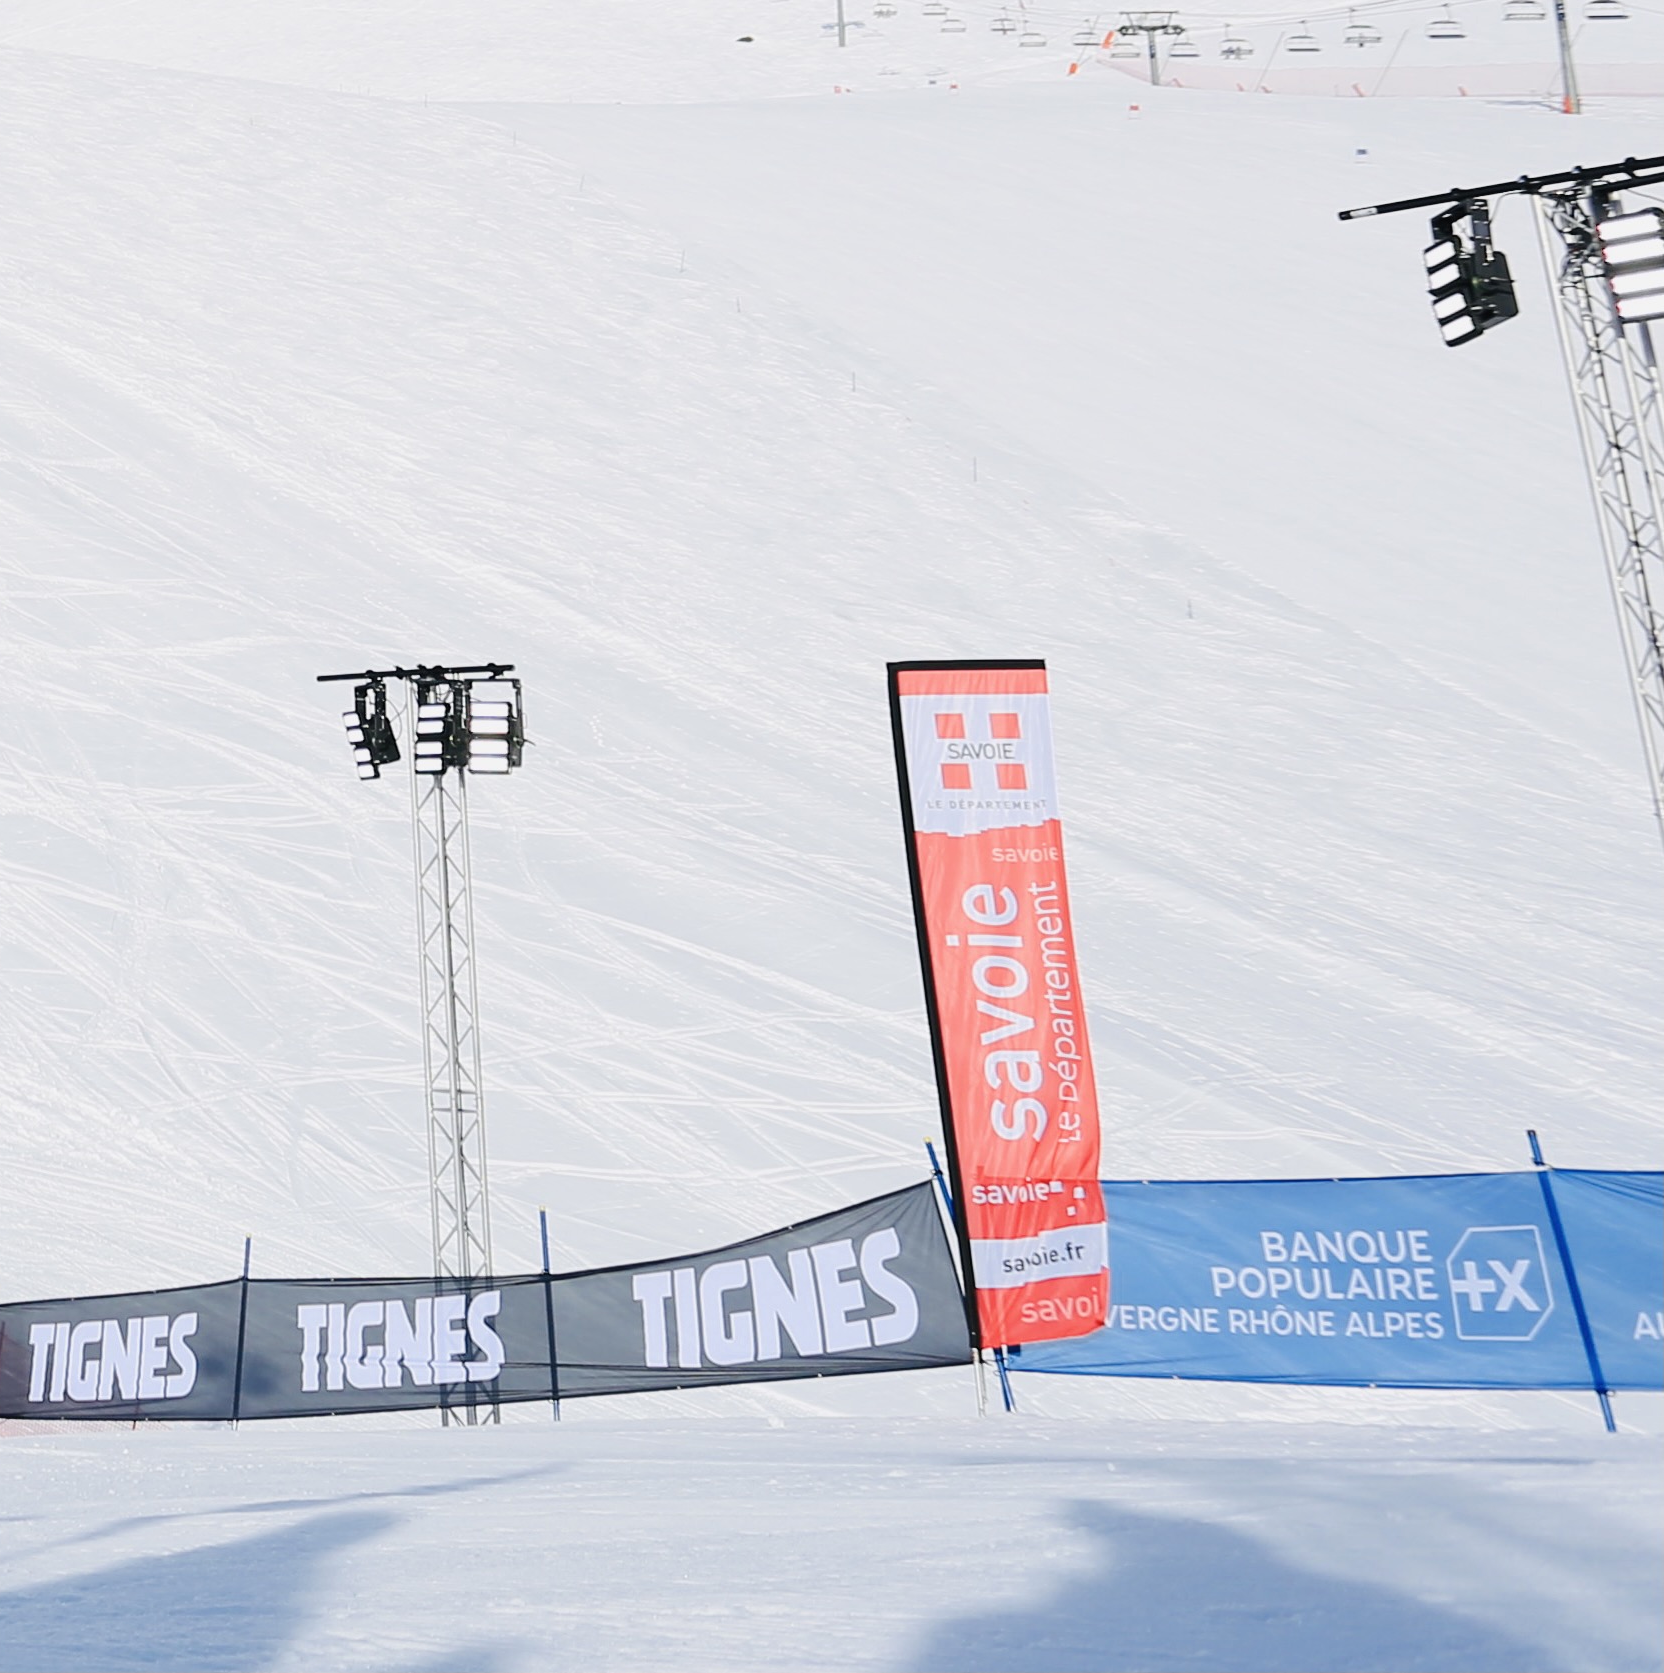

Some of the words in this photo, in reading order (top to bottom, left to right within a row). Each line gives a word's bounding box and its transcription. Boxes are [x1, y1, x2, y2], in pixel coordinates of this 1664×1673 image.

[947, 743, 1015, 760] SAVOIE
[927, 800, 943, 809] LE
[949, 798, 1047, 810] DÉPARTEMENT
[992, 842, 1059, 863] savoie
[1028, 881, 1081, 1102] Département
[946, 883, 1048, 1142] savoie
[972, 1177, 1050, 1204] savoie
[1260, 1230, 1432, 1264] BANQUE
[632, 1227, 920, 1369] TIGNES
[1211, 1267, 1439, 1301] POPULAIRE
[1228, 1304, 1333, 1336] RHÔNE
[1345, 1311, 1444, 1339] ALPES
[28, 1312, 199, 1402] TIGNES
[297, 1290, 506, 1392] TIGNES
